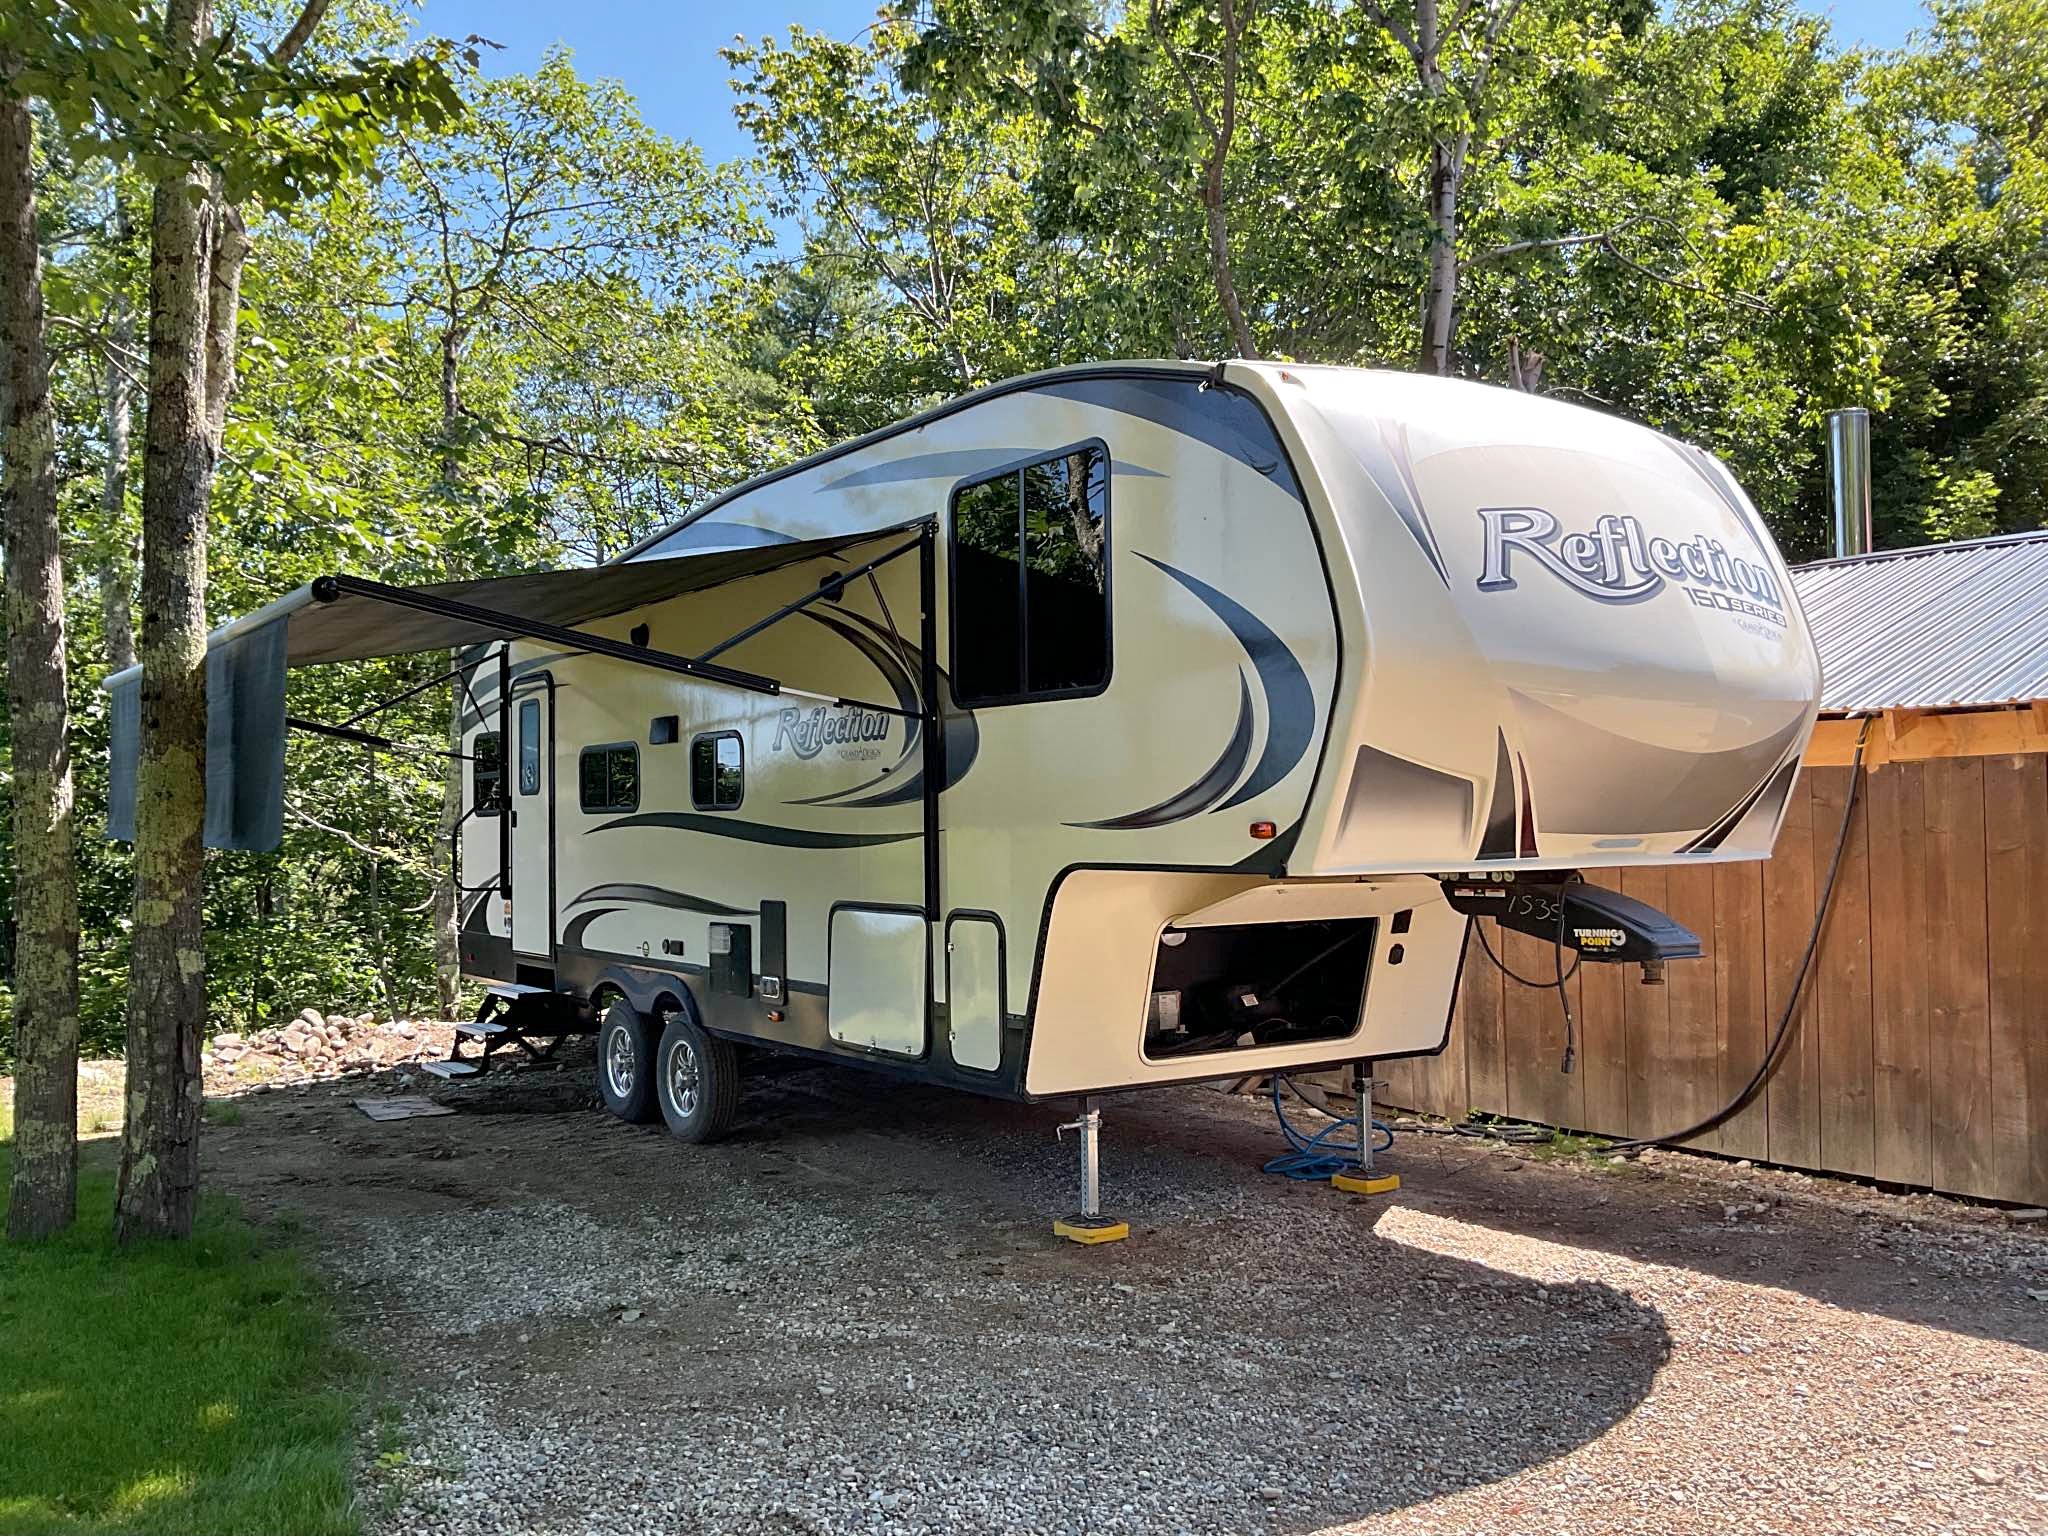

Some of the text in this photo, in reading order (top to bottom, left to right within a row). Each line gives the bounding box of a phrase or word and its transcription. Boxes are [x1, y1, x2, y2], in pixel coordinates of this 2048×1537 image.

[1476, 507, 1783, 611] Reflection
[1730, 599, 1787, 628] SERIES
[772, 706, 890, 760] Reflection
[1573, 928, 1617, 938] TURNING
[1580, 937, 1611, 946] POINT
